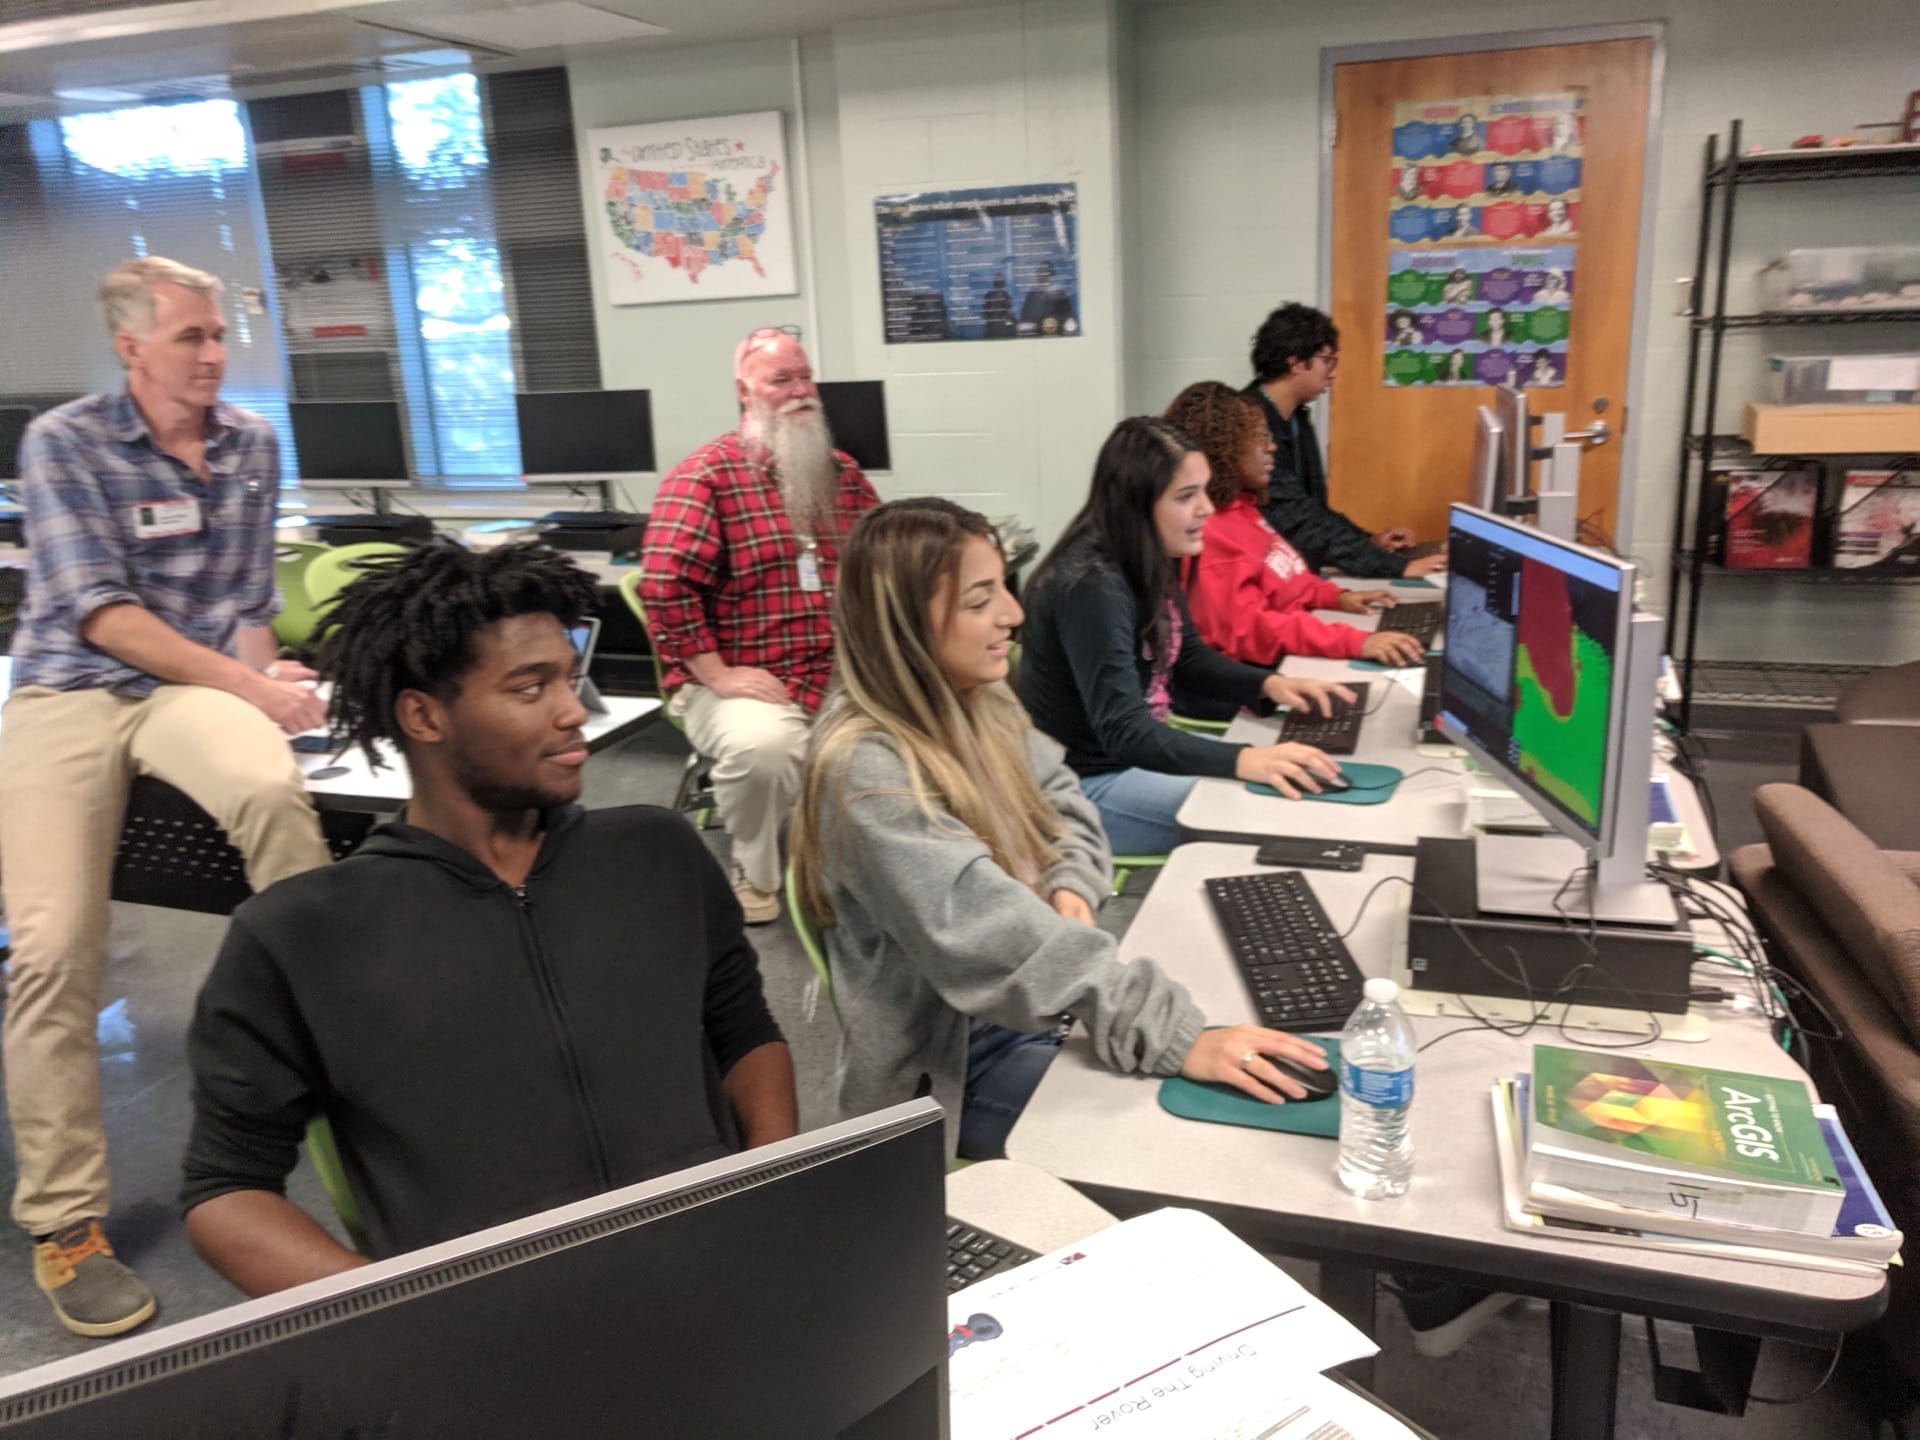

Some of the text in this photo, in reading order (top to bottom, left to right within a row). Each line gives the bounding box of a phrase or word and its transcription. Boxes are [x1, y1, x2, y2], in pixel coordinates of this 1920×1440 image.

[1720, 1086, 1780, 1162] ArcGIS
[1667, 1181, 1710, 1220] 15
[1091, 1343, 1257, 1431] Driving The Rover
